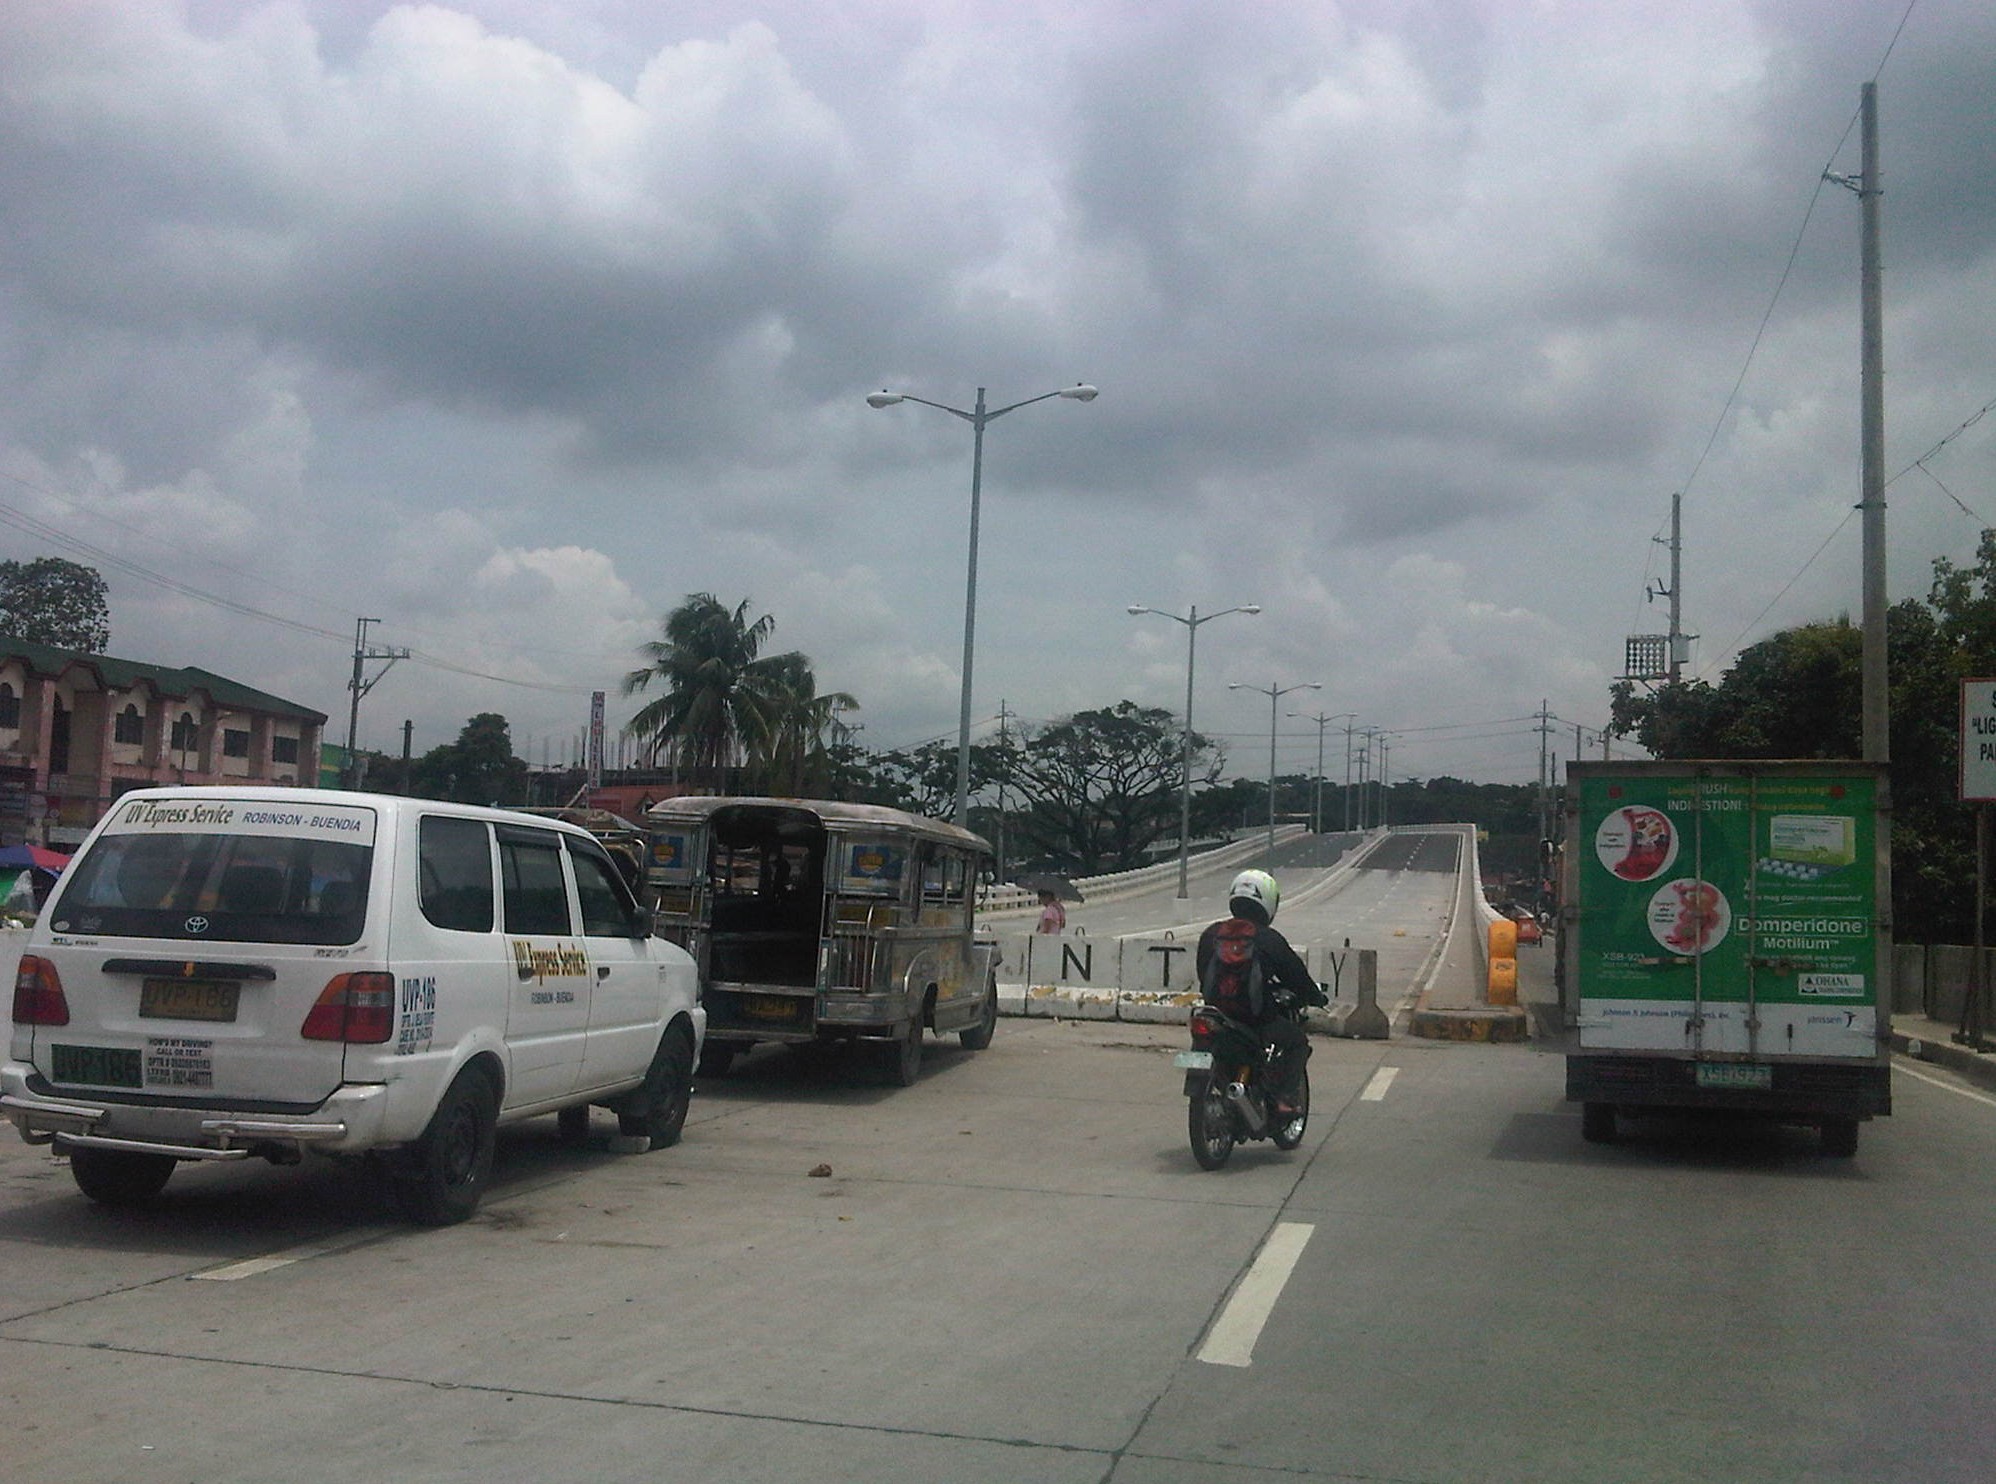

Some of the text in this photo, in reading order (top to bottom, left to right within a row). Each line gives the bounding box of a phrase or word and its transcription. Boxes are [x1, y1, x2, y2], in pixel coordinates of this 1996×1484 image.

[125, 804, 144, 823] UV
[144, 804, 188, 827] Express
[189, 803, 234, 823] Service
[242, 811, 301, 825] ROBINSON
[310, 816, 360, 832] BUENDIA
[1738, 917, 1862, 934] Domperidone
[1061, 943, 1347, 998] N T Y
[1815, 976, 1849, 986] OHANA
